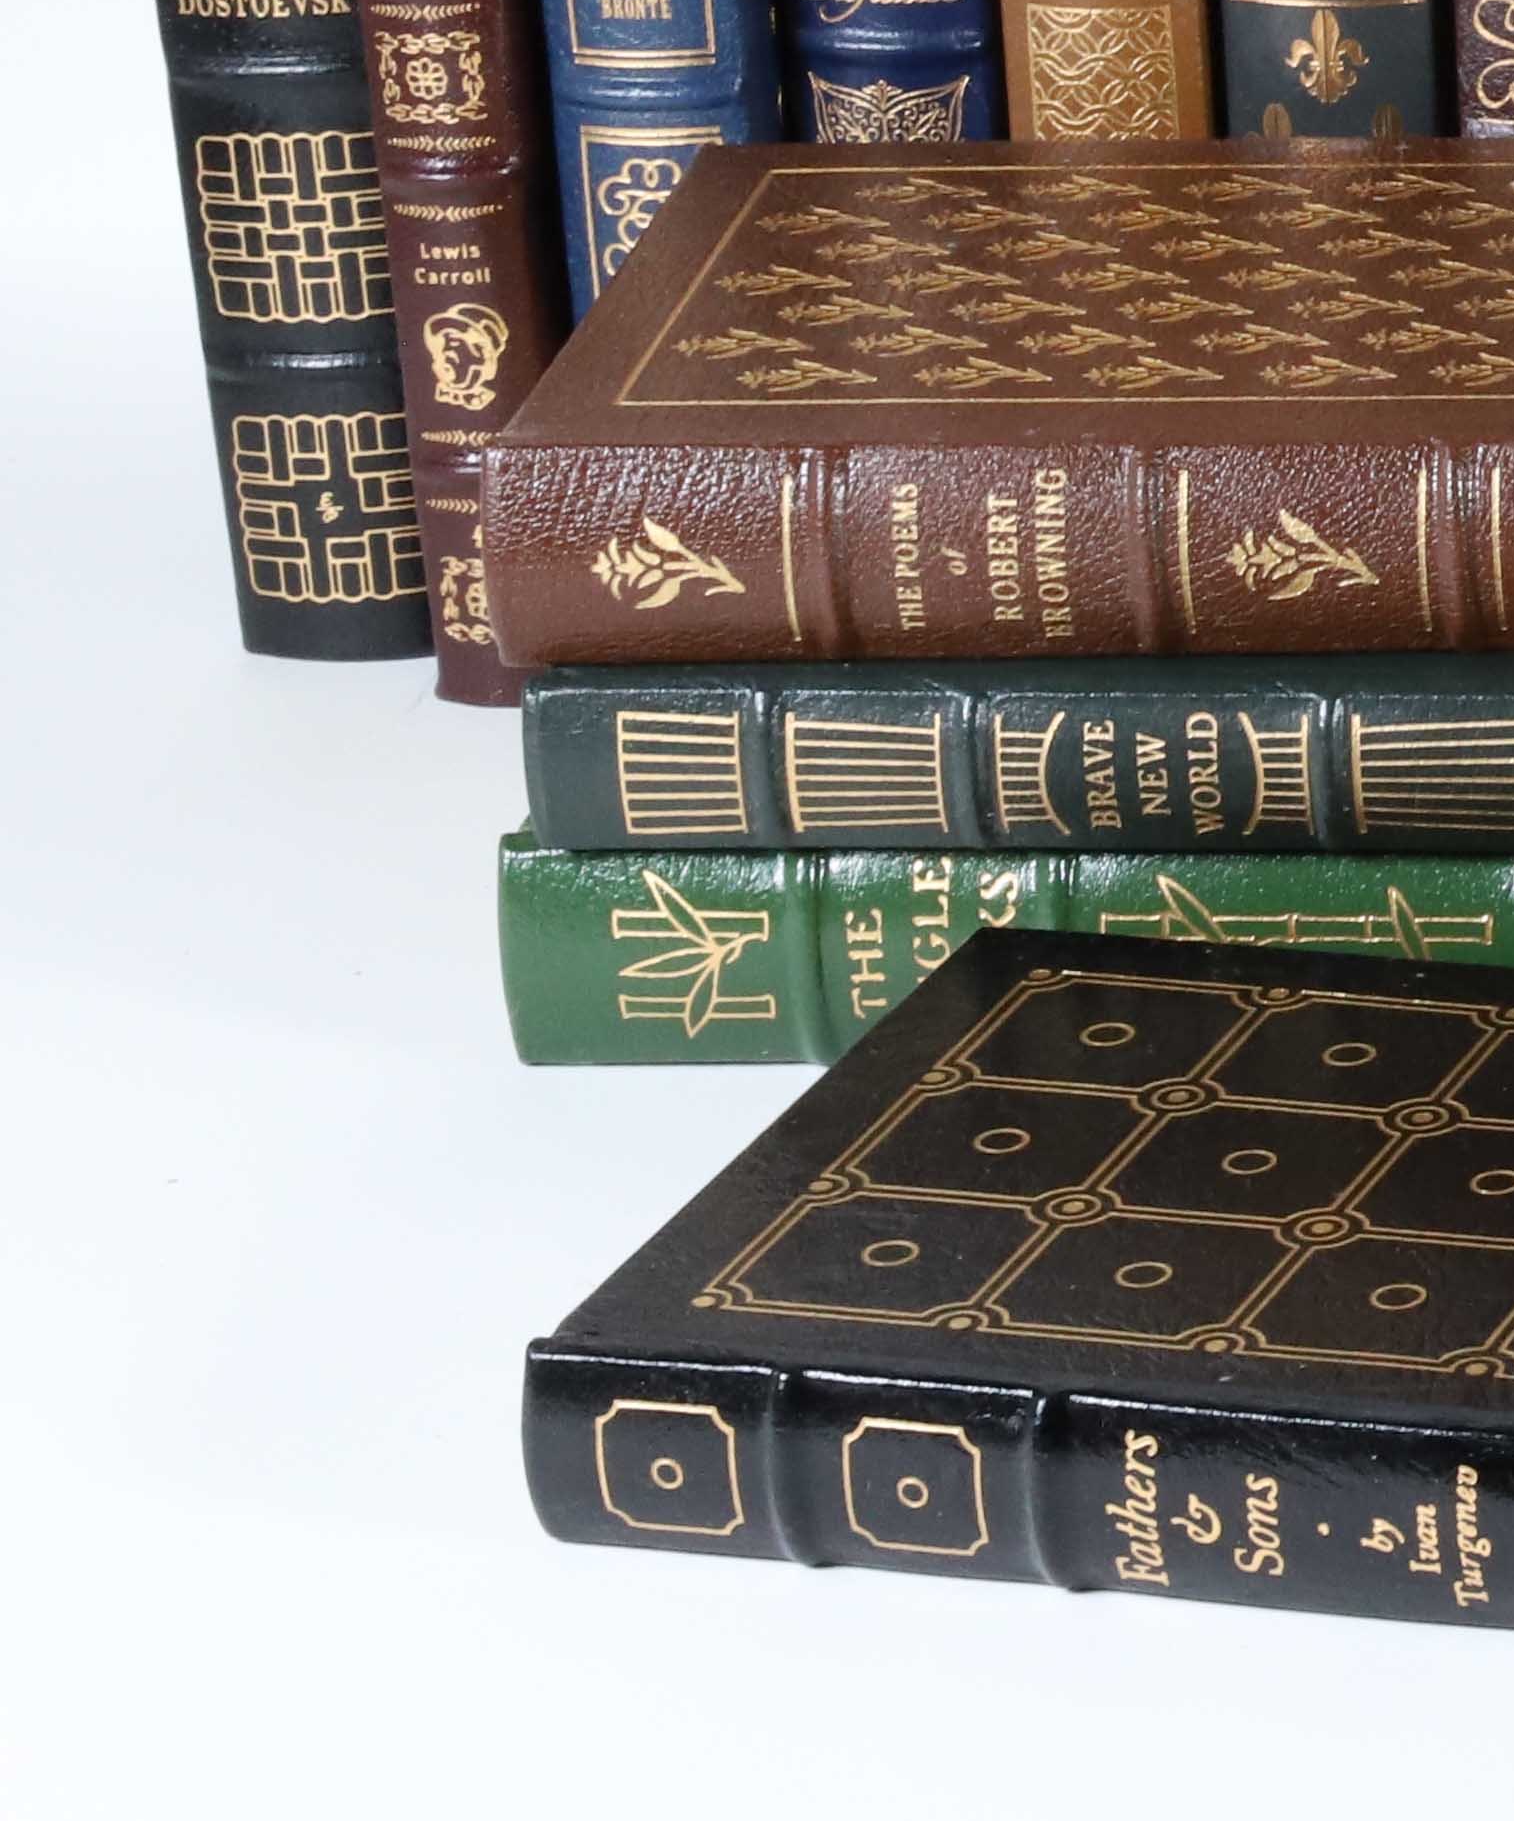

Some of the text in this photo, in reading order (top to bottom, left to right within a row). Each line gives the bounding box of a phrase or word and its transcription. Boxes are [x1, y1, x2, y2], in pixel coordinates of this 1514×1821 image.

[414, 266, 492, 287] Carroll
[419, 241, 481, 262] Lewis
[891, 482, 924, 579] POEMS
[986, 491, 1025, 622] ROBERT
[1033, 465, 1074, 639] BROWNING
[1081, 716, 1123, 831] BRAVE
[1135, 730, 1172, 818] NEW
[1185, 710, 1227, 836] WORLD
[844, 907, 888, 1019] THE
[1105, 1428, 1171, 1588] Fathers
[1233, 1471, 1286, 1577] Sons
[1408, 1502, 1443, 1577] Ivan
[1453, 1463, 1493, 1609] Turgenev
